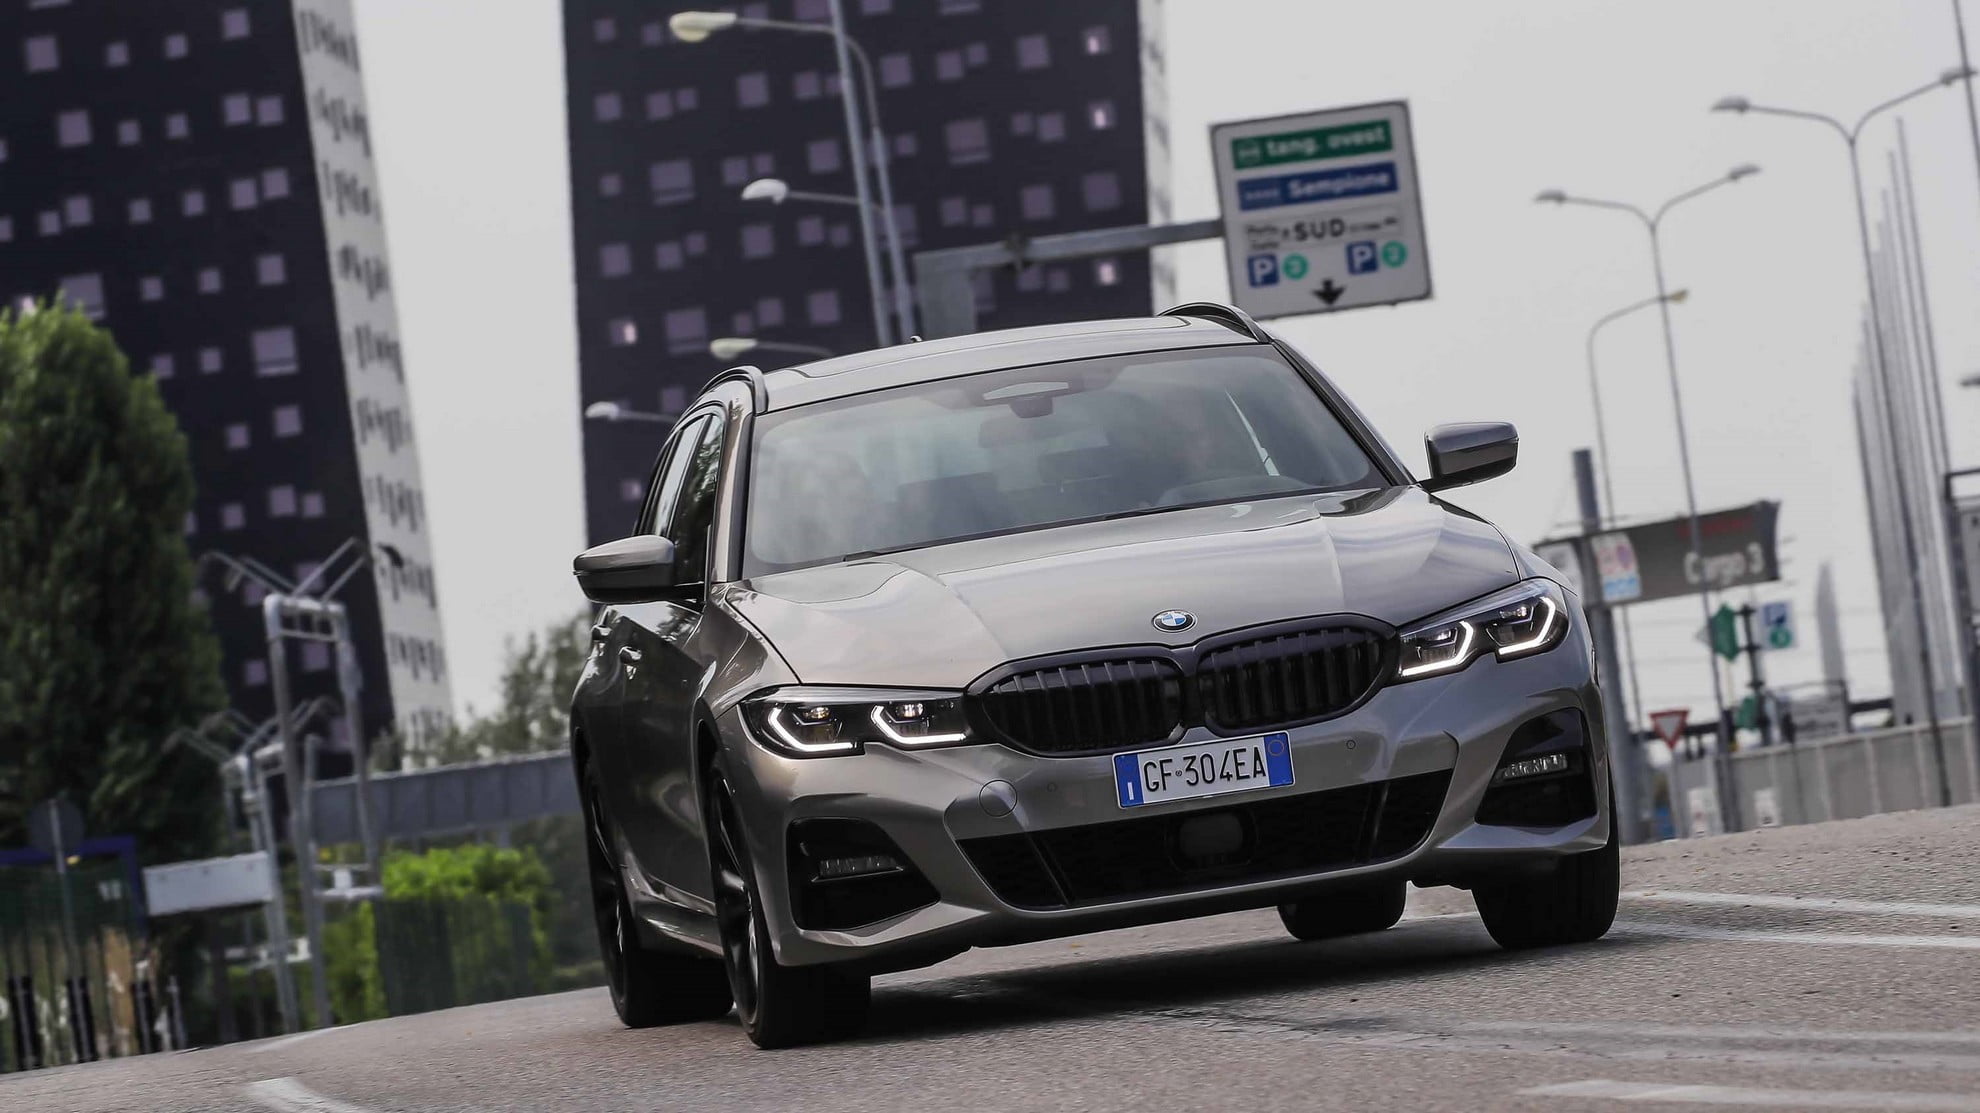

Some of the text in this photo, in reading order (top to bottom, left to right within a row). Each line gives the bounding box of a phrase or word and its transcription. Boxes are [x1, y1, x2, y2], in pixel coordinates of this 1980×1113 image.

[1294, 218, 1346, 242] SUD
[1253, 258, 1275, 286] P
[1353, 245, 1374, 274] P
[1143, 745, 1267, 793] GF 304EA
